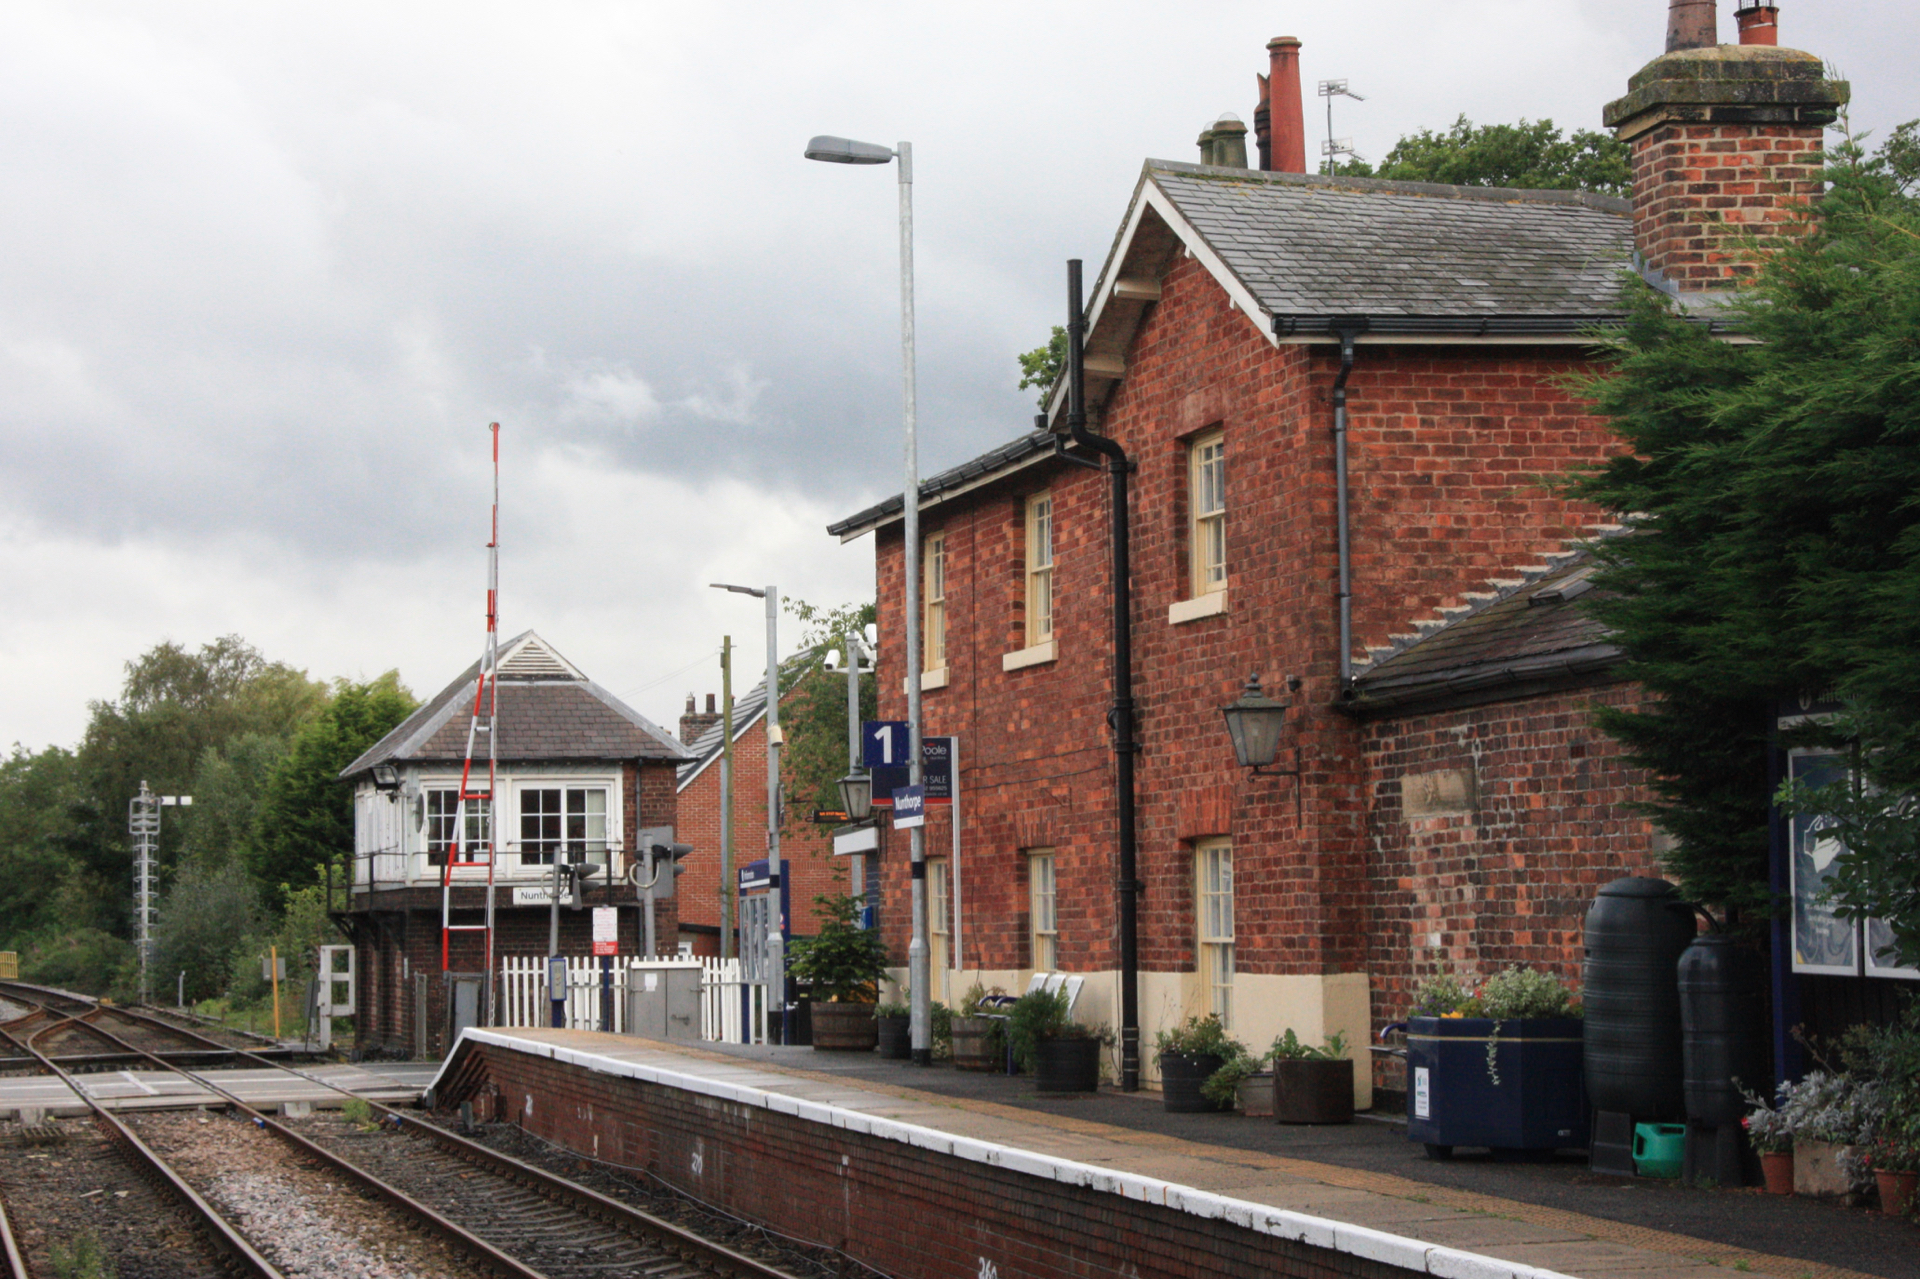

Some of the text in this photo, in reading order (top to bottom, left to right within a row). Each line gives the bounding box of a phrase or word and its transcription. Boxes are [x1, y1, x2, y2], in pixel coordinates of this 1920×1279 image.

[873, 725, 892, 764] 1
[929, 775, 947, 784] SALE
[895, 794, 921, 811] Nunthorpe
